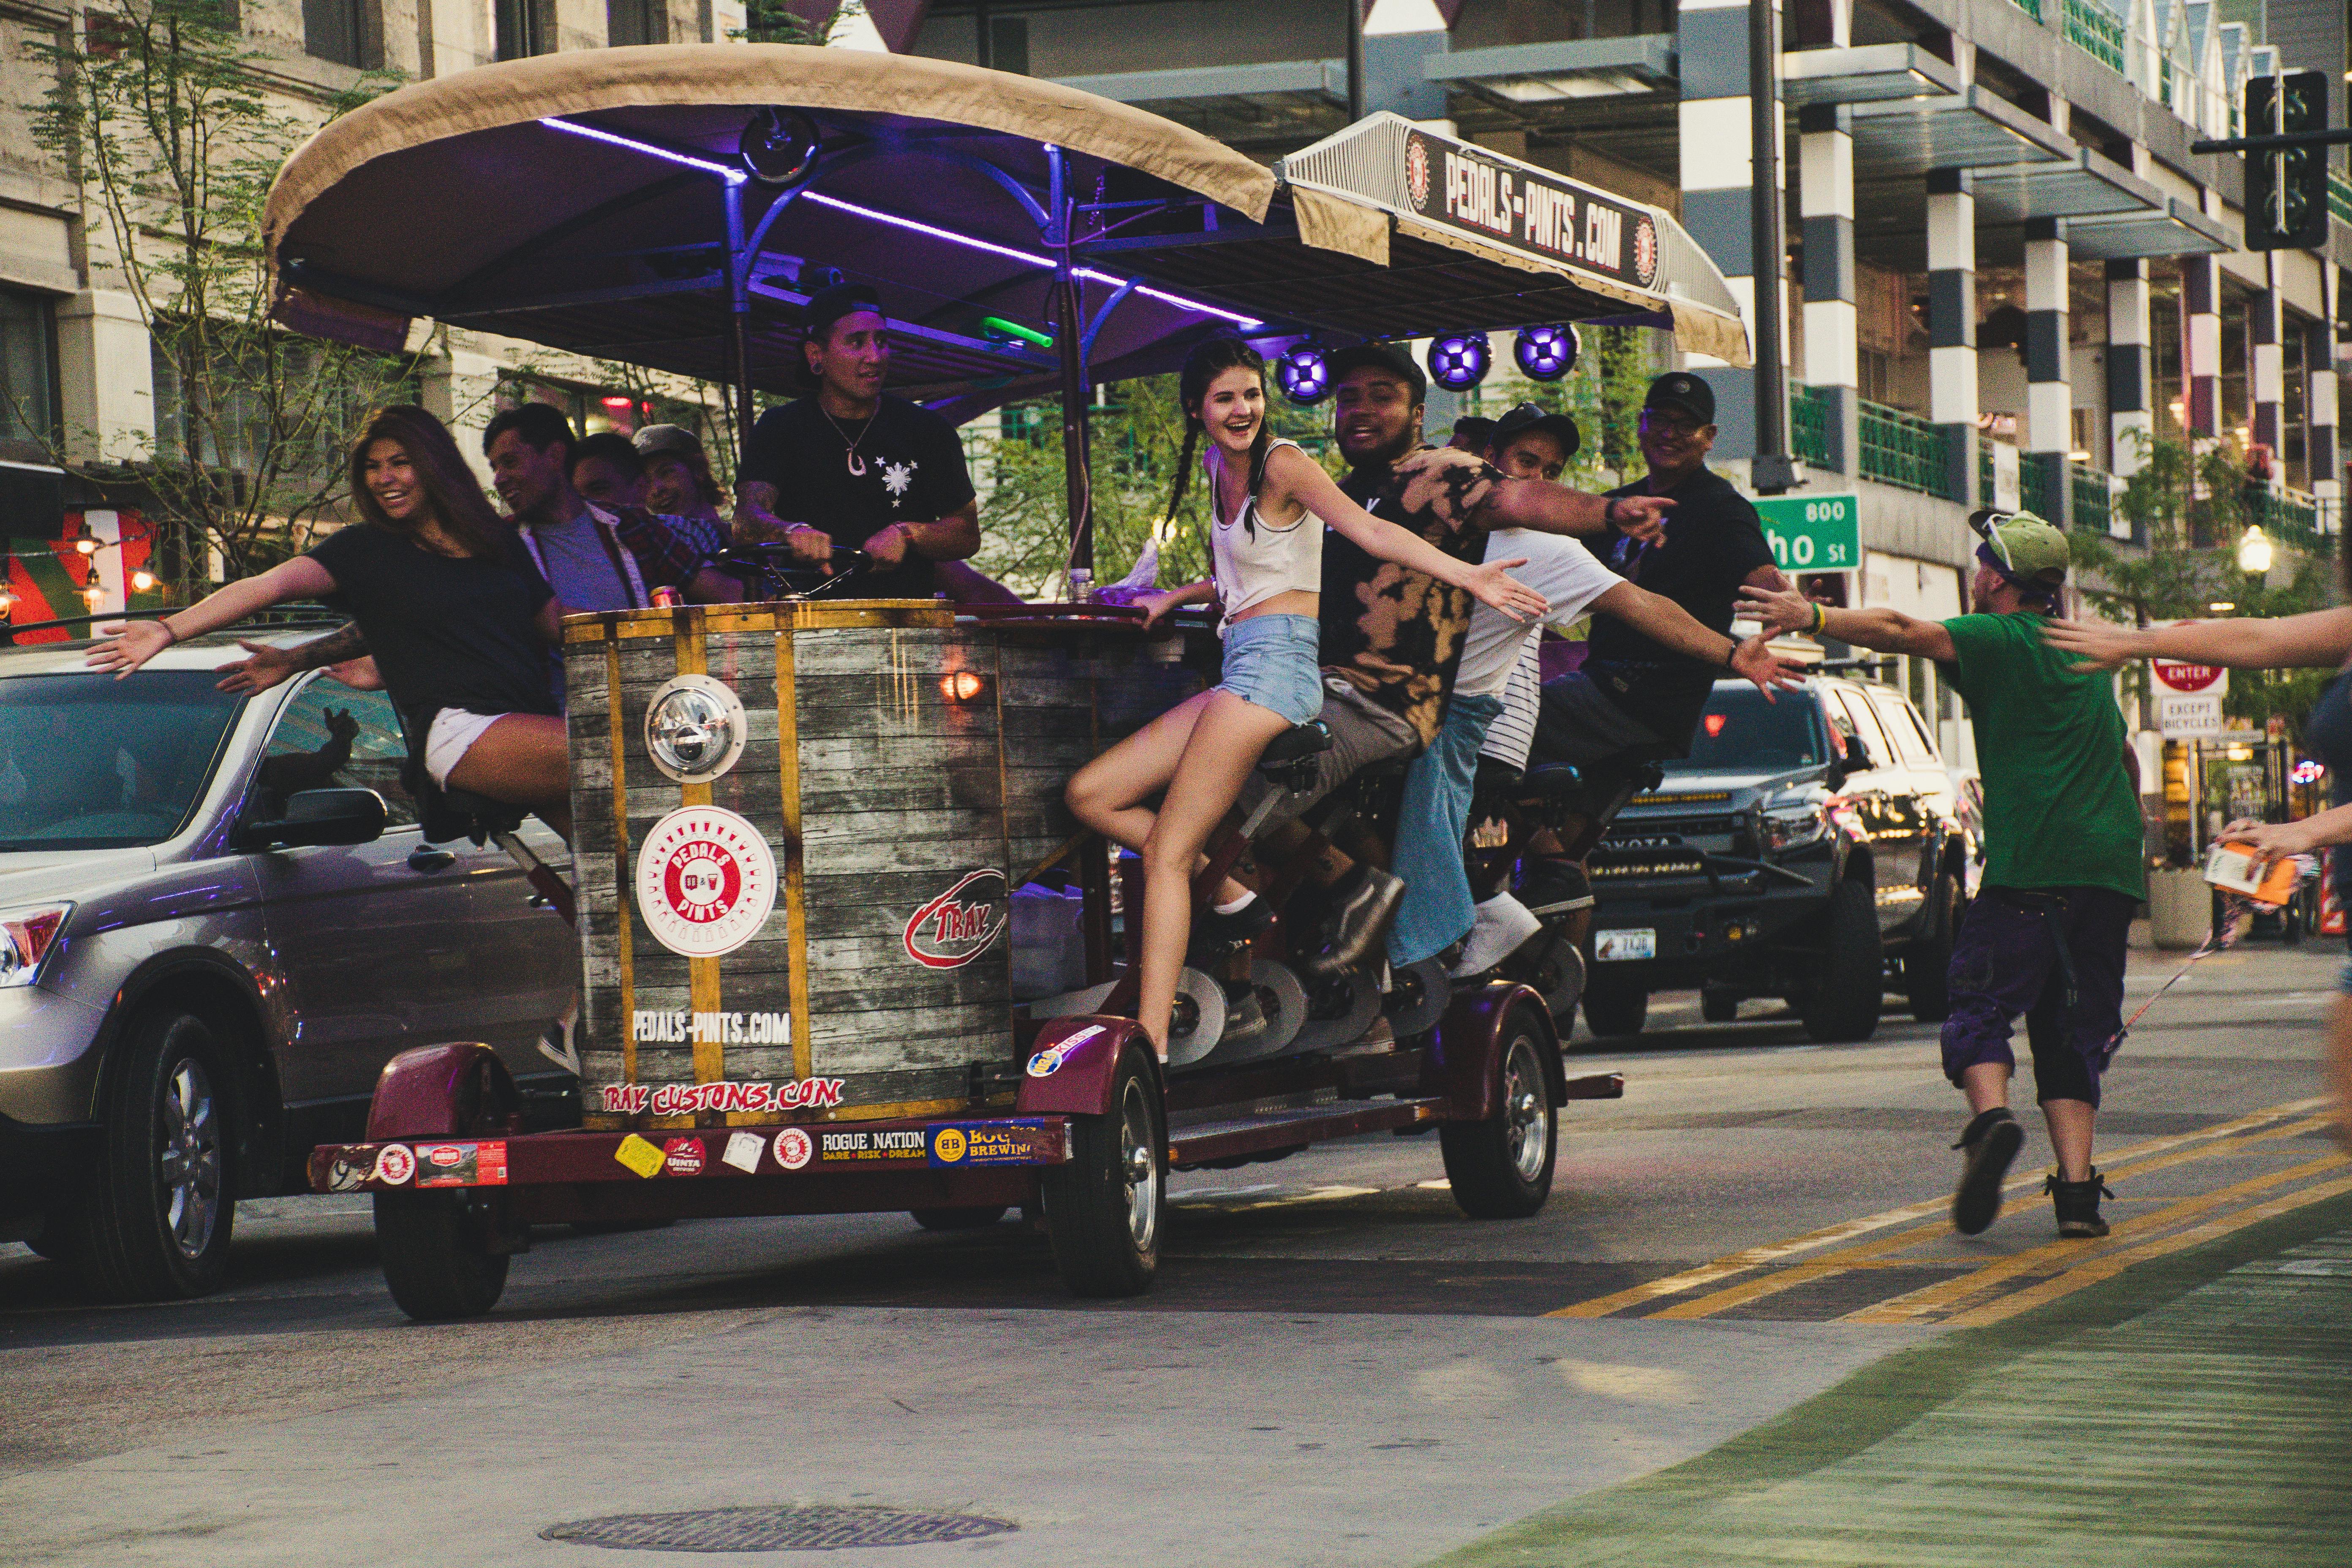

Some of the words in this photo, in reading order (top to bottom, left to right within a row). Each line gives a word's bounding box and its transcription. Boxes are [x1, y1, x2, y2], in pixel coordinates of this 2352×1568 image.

[1805, 501, 1845, 523] 800
[1828, 543, 1846, 563] St
[2168, 667, 2210, 680] ENTER
[2170, 702, 2210, 714] EXCEPT
[2164, 718, 2218, 729] BICYCLES
[671, 843, 731, 869] PEDALS
[676, 898, 729, 921] PINTS
[933, 900, 991, 944] TRAX
[633, 1010, 790, 1044] PEDALS-PINTS.COM
[822, 1133, 868, 1150] ROGUE
[873, 1132, 925, 1149] NATION
[969, 1143, 1031, 1156] BREWIN
[667, 1157, 701, 1167] UINTA
[822, 1151, 850, 1160] DARE
[857, 1150, 881, 1159] RISK
[888, 1149, 926, 1158] DREAM
